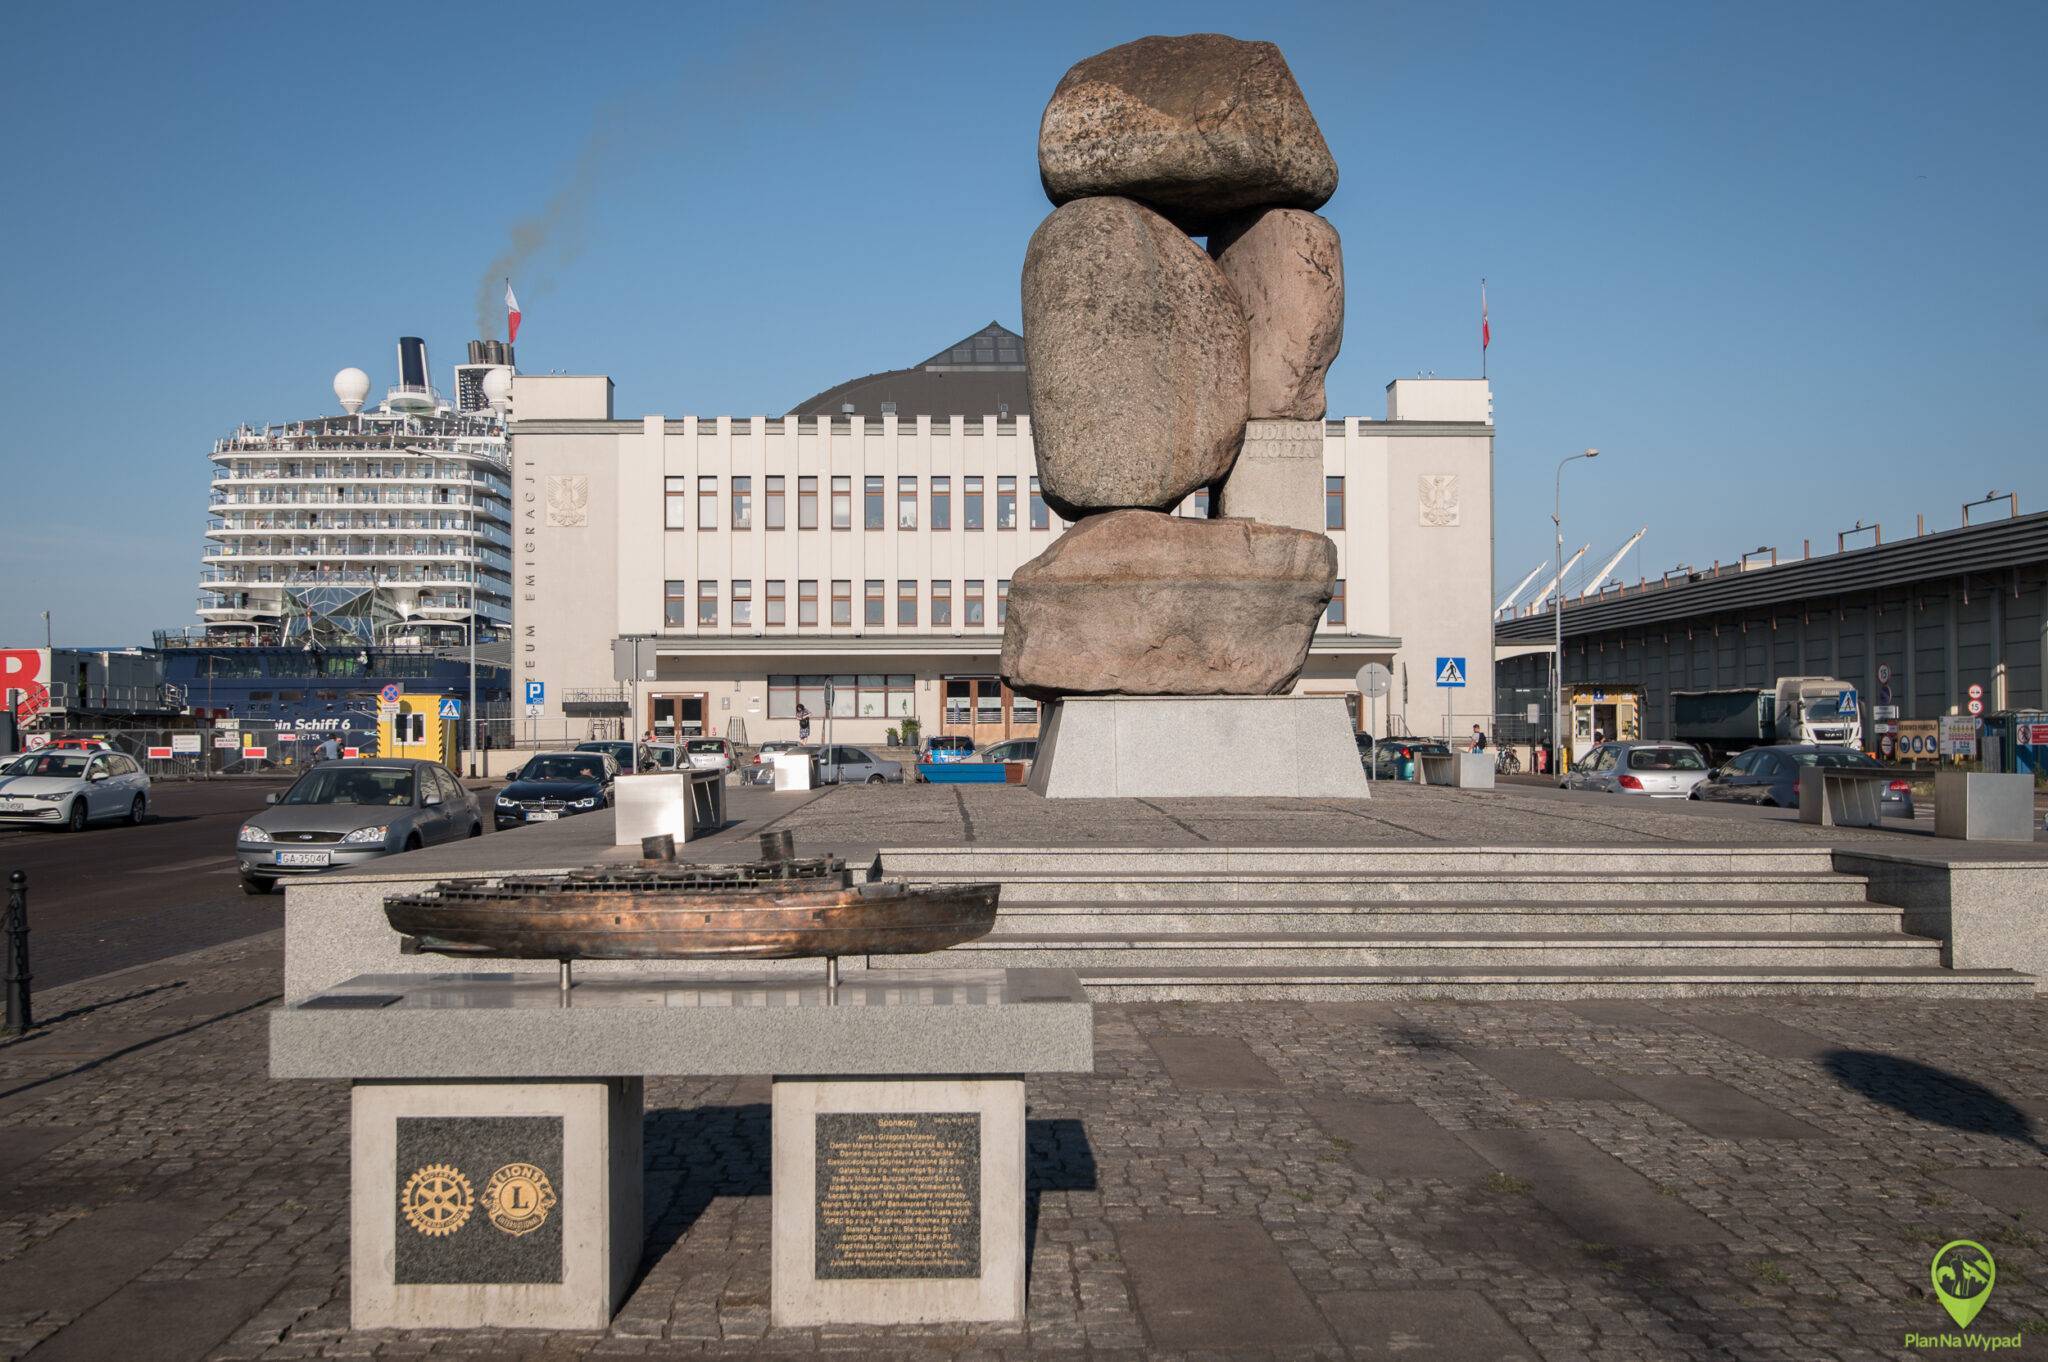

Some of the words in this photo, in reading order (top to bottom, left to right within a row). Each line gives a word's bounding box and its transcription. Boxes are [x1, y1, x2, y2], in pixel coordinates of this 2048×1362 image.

[525, 462, 535, 601] EMIGRACJI
[529, 683, 542, 699] P
[1971, 702, 1980, 711] 15
[295, 718, 340, 730] Schiff
[341, 719, 351, 730] 6
[879, 1119, 918, 1128] Sponsorzy
[496, 1166, 543, 1182] LIONS
[511, 1186, 529, 1209] L
